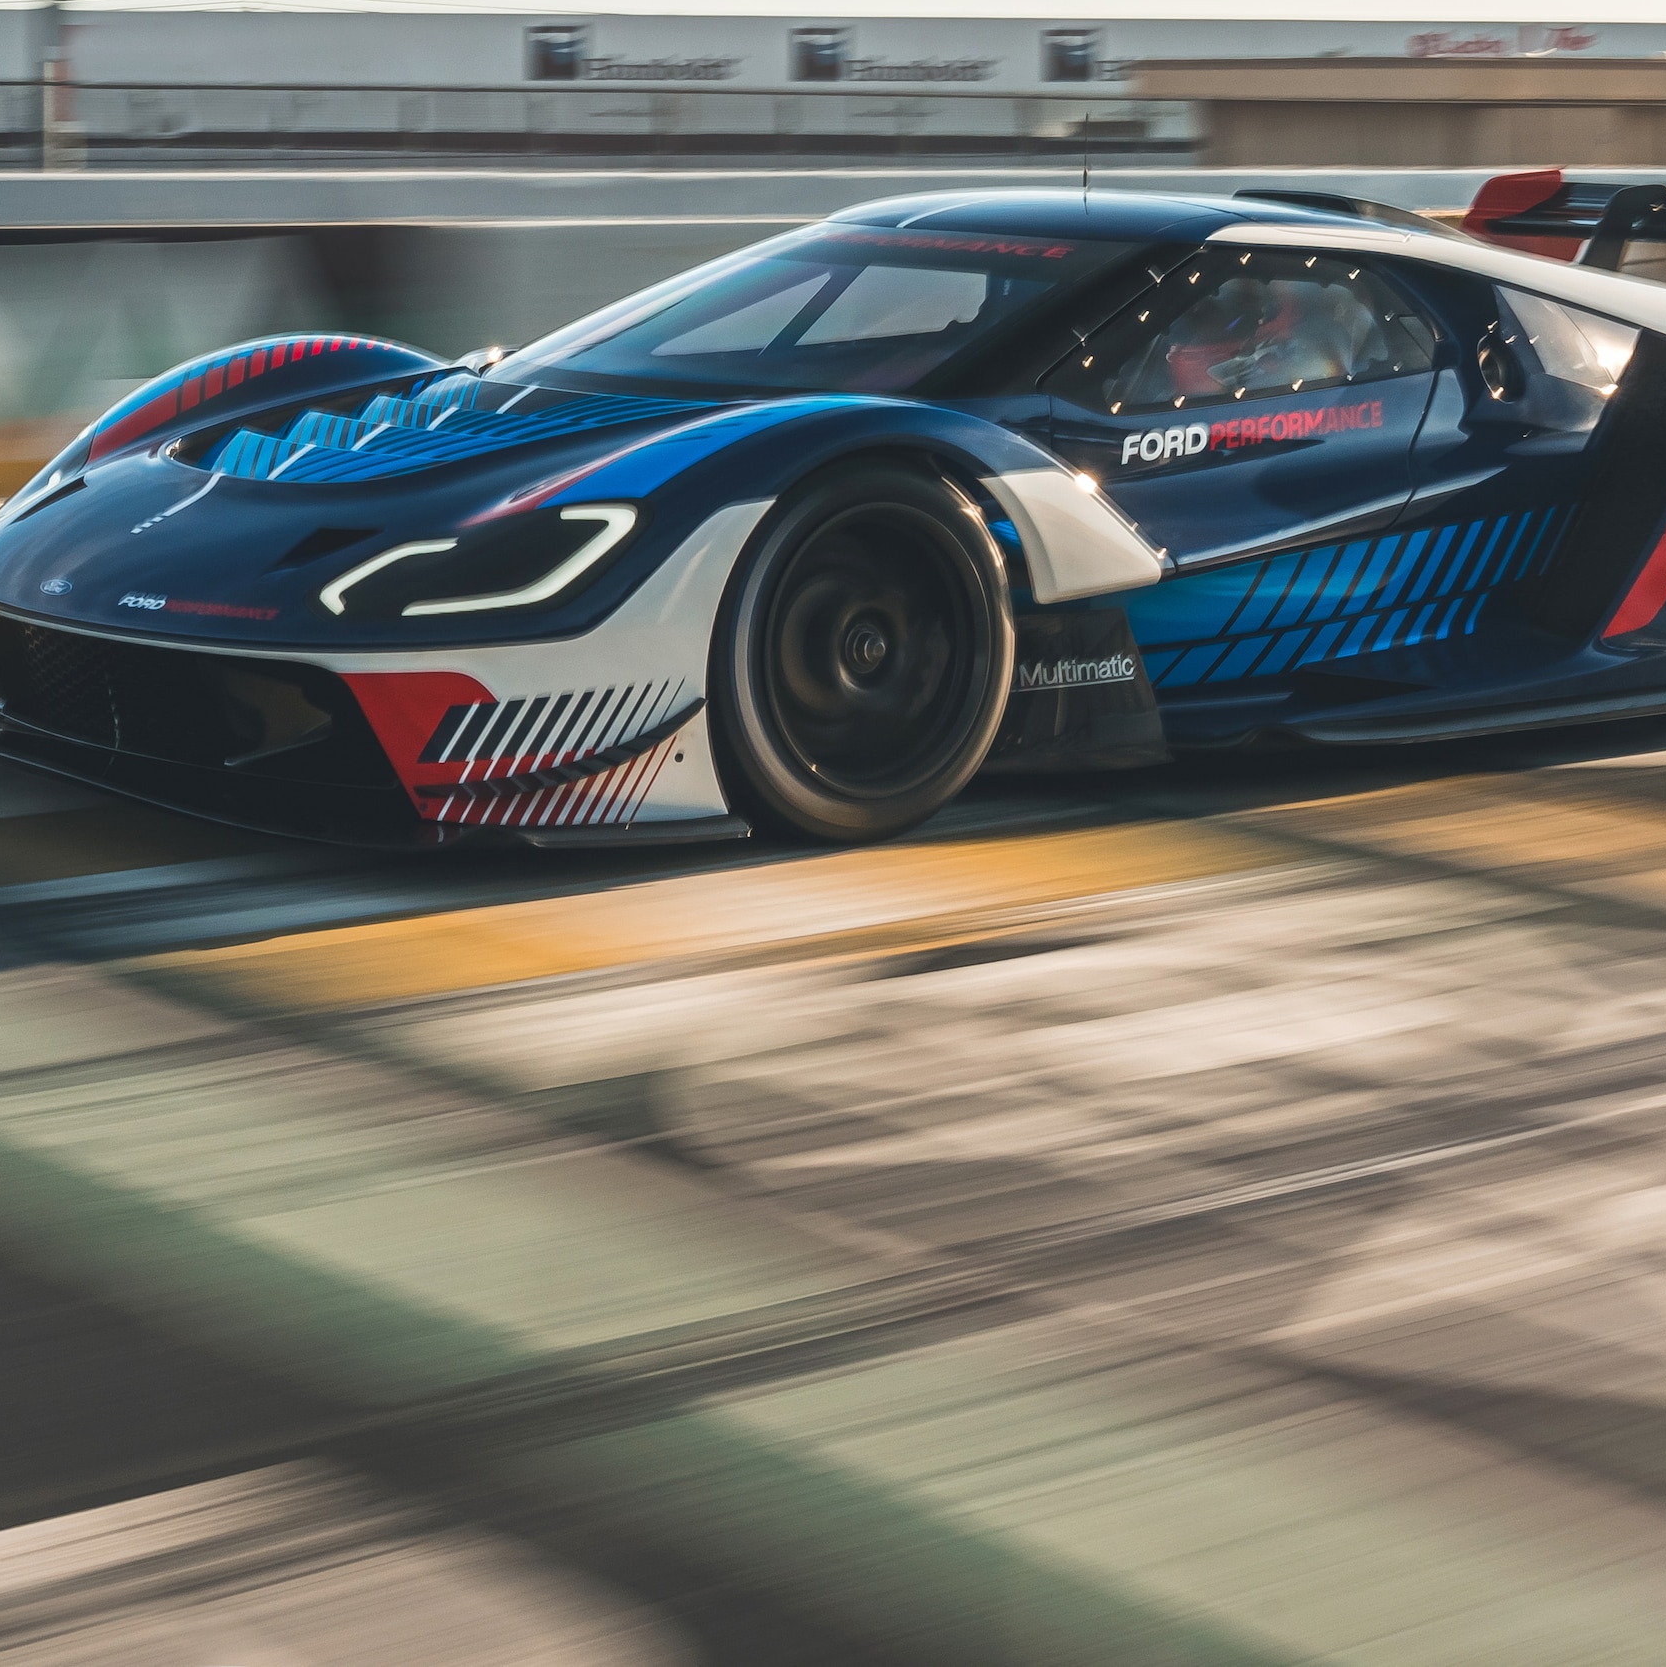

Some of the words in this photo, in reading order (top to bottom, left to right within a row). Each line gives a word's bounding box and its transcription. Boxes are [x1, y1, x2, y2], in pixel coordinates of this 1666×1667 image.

[1121, 423, 1210, 465] FORD
[1209, 400, 1383, 451] PERFORMANCE
[117, 594, 167, 611] FORD
[1019, 653, 1135, 688] Multimatic
